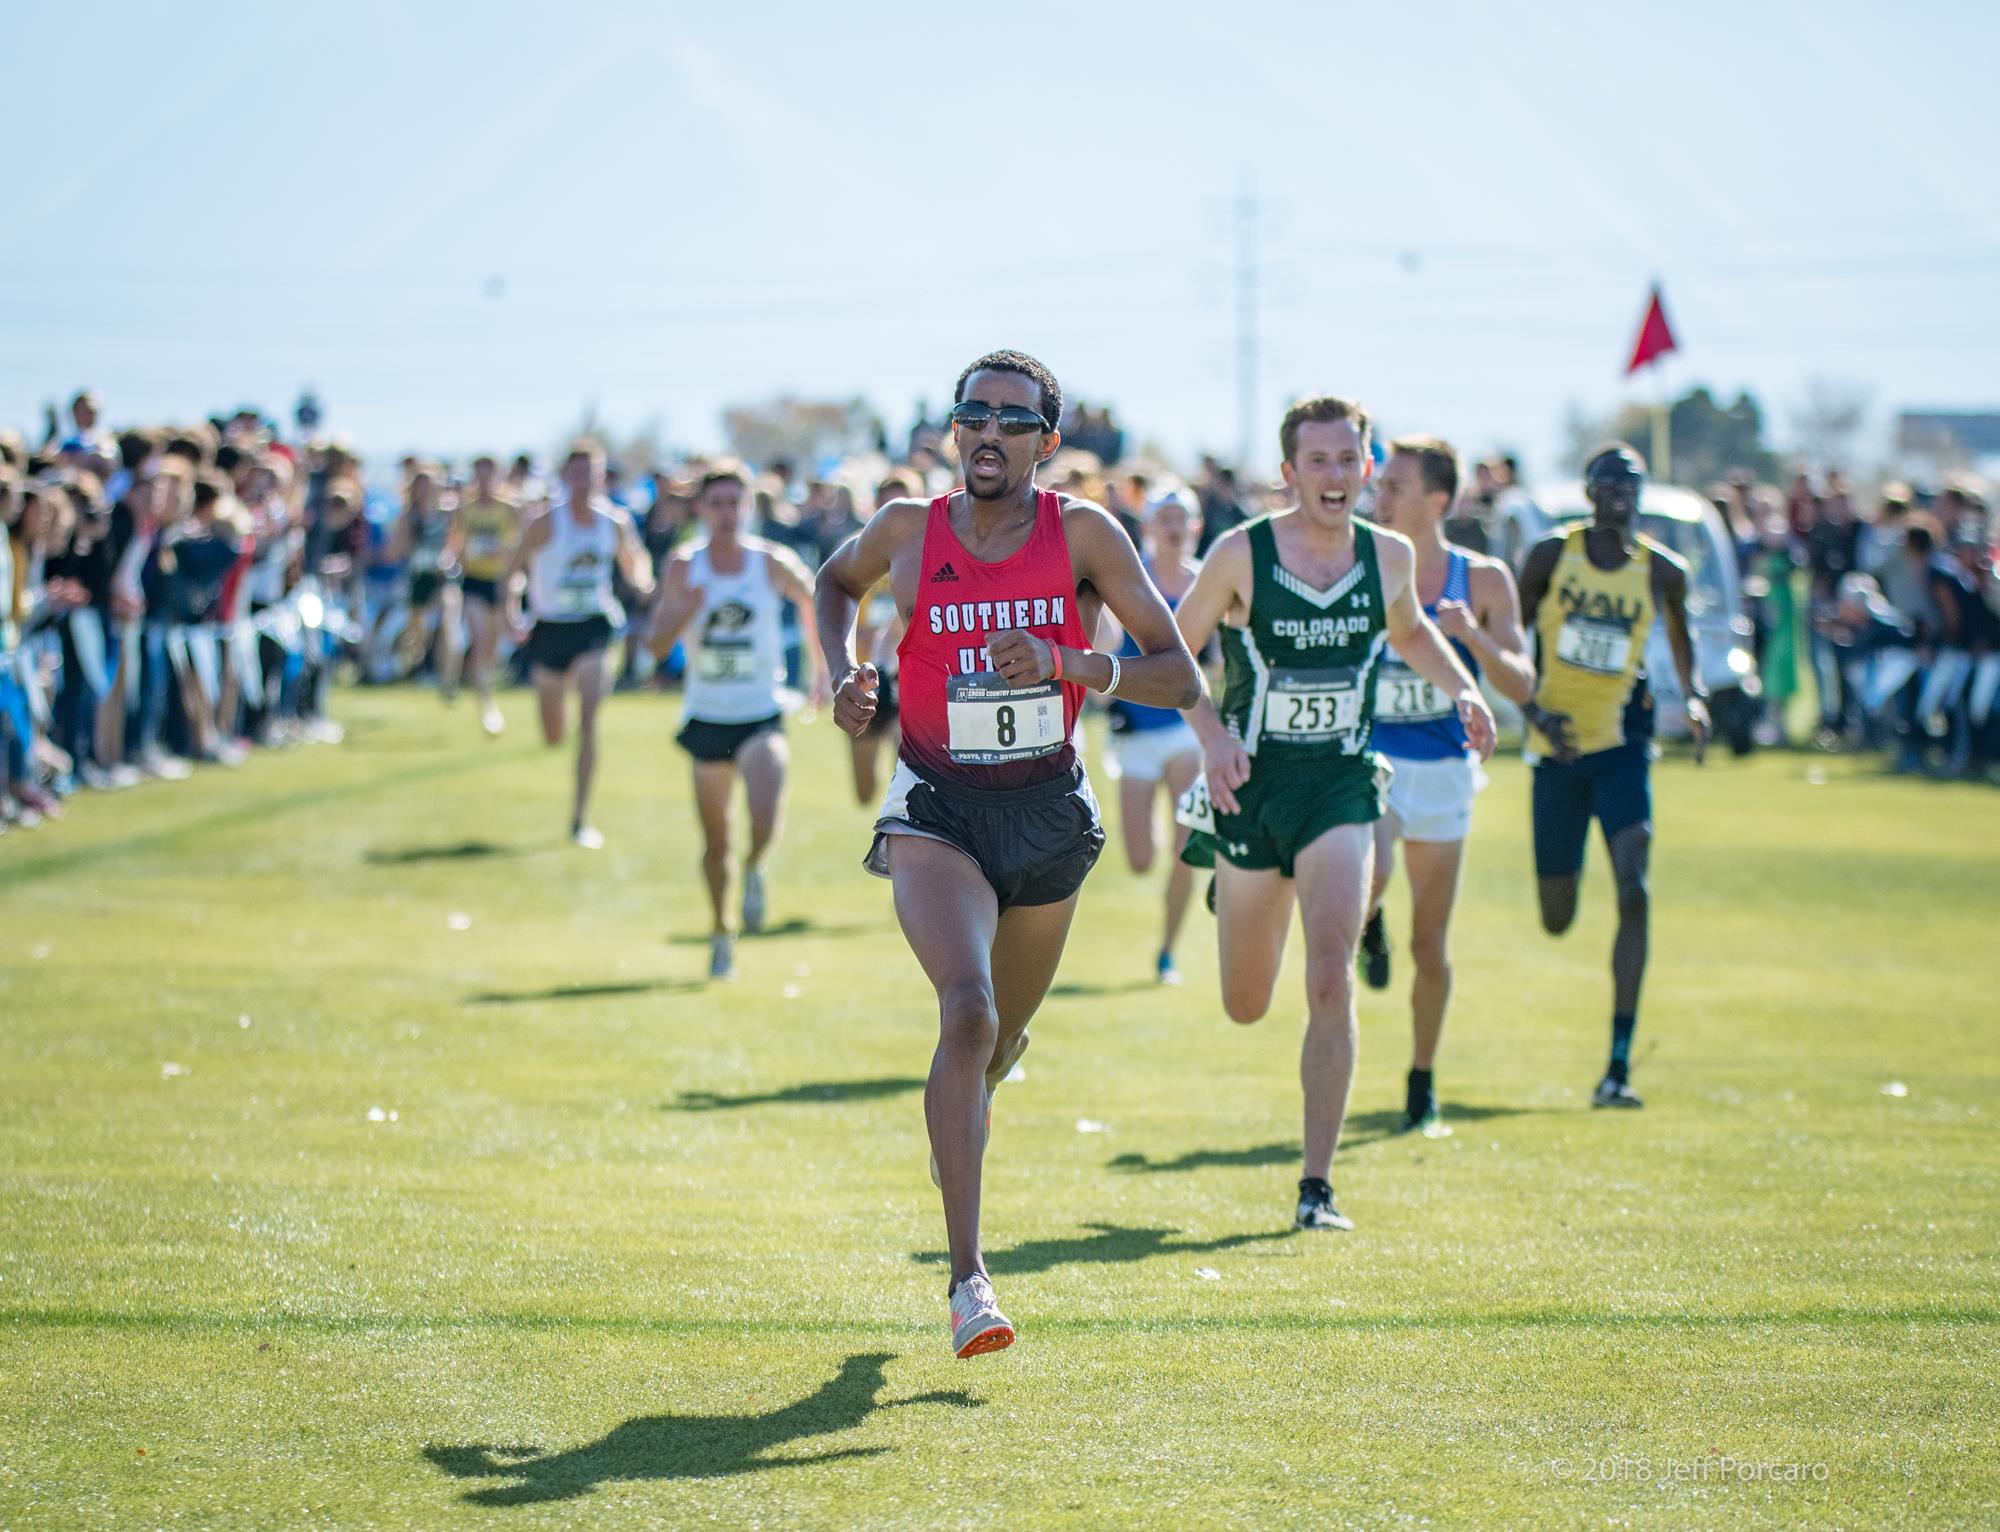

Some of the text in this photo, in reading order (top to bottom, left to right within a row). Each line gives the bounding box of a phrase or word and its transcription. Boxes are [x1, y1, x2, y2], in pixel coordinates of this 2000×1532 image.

[929, 596, 1065, 634] SOUTHERN
[1560, 587, 1642, 623] NAU
[1272, 616, 1369, 637] COLORADO
[1295, 633, 1349, 650] STATE
[986, 689, 1010, 697] COUNTRY
[1010, 685, 1051, 696] CHAMPIONSHIPS
[996, 705, 1017, 747] 8
[1288, 697, 1337, 729] 253
[999, 751, 1033, 761] NOVEMBER
